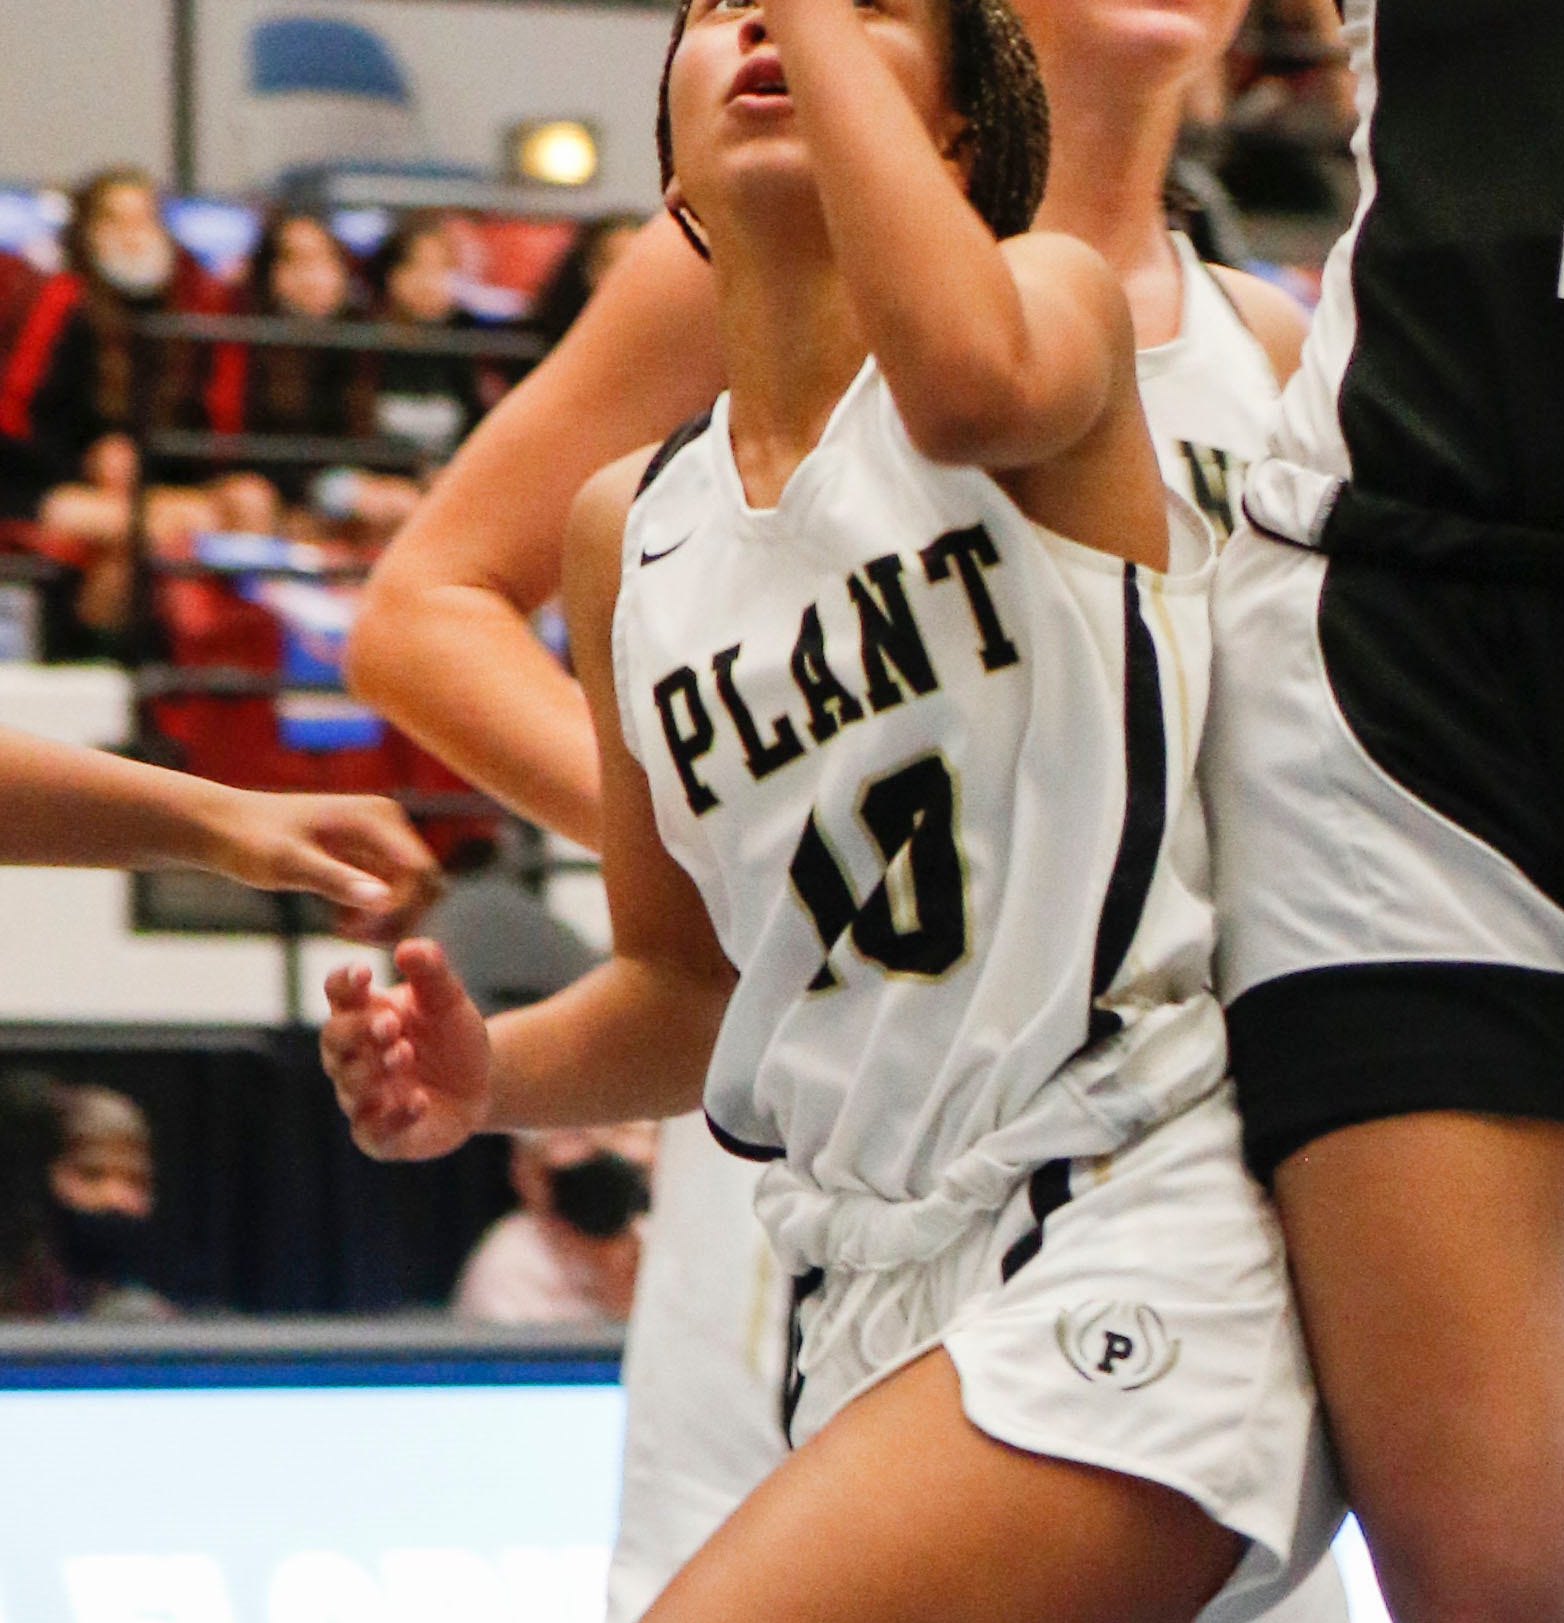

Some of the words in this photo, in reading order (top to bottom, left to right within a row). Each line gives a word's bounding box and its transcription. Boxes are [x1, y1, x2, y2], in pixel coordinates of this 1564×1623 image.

[650, 522, 1022, 817] PLANT
[785, 751, 971, 994] 10
[1096, 1329, 1134, 1375] P
